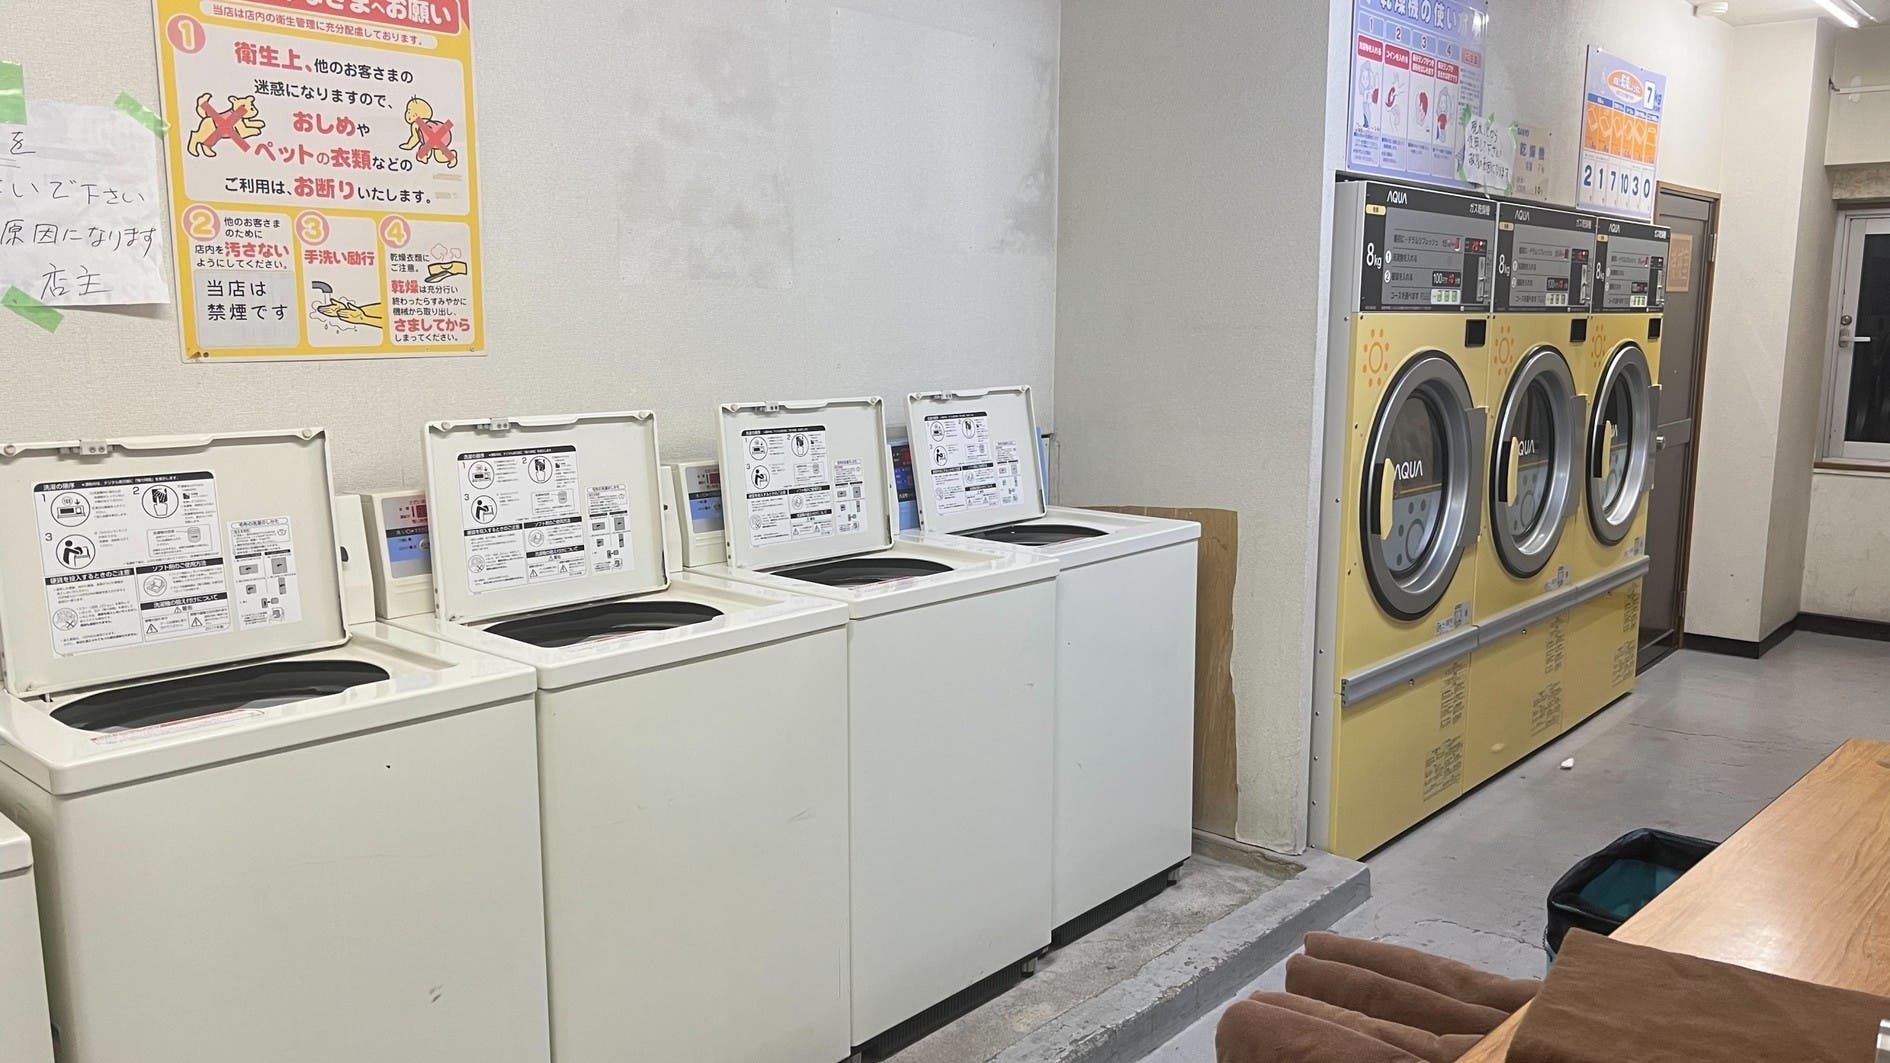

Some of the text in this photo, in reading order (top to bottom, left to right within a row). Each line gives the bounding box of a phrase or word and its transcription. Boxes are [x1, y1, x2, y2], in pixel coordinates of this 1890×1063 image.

[212, 3, 424, 45] 当店は店内の衛生管理に充分配慮しております。
[234, 41, 414, 83] 衛生上、他のお客さまの
[253, 79, 394, 110] 迷惑になりますので、
[291, 111, 370, 138] おしめや
[9, 131, 36, 154] を
[255, 142, 413, 172] ペットの衣類などの
[1583, 164, 1651, 198] 2 1 7 10 3 0
[0, 179, 145, 205] いで下さい
[224, 176, 432, 205] ご利用は、お断りいたします。
[1386, 190, 1408, 205] AQUA
[224, 217, 281, 229] 他のお客さま
[1514, 209, 1530, 221] AQUA
[224, 228, 263, 240] のために
[1608, 223, 1621, 233] AQUA
[194, 241, 290, 259] 店内を汚さない
[304, 249, 376, 266] 手洗い励行
[390, 252, 430, 263] 乾燥衣類に
[1366, 243, 1382, 269] 8kg
[196, 257, 288, 270] ようにしてください。
[390, 263, 420, 273] ご注意。
[1498, 254, 1510, 277] 8kg
[40, 262, 112, 300] 店主
[207, 279, 267, 297] 当店は
[391, 279, 459, 295] 乾燥は充分行い
[392, 296, 467, 307] 終わったらすみやかに
[207, 303, 289, 321] 禁煙です
[392, 307, 457, 317] 機械から取り出し、
[393, 318, 471, 332] さましてから
[394, 333, 460, 342] しまってください。
[1518, 439, 1535, 456] QUA
[1393, 460, 1423, 481] AQUA
[132, 486, 140, 495] 2
[44, 532, 53, 542] 3
